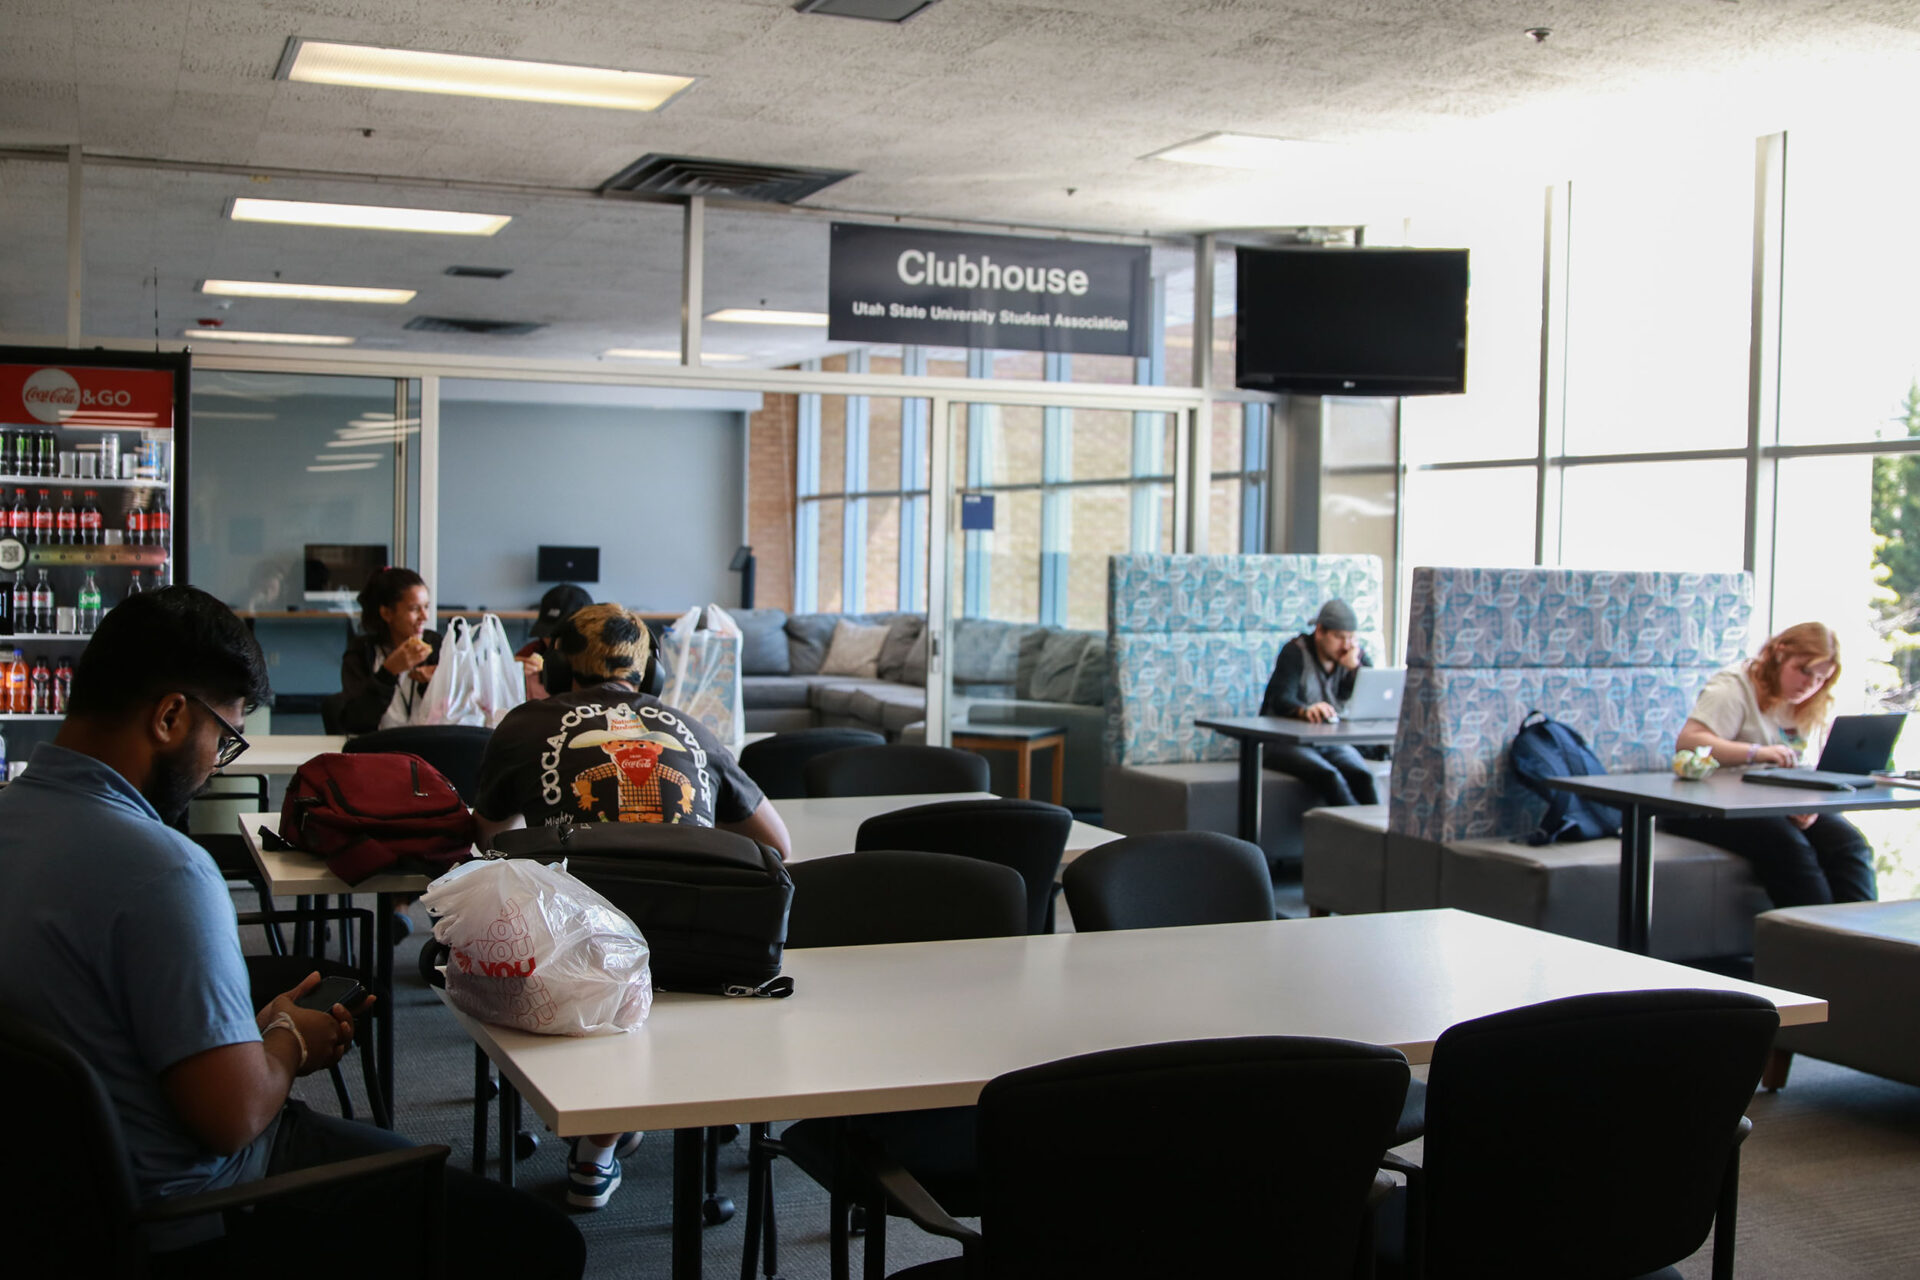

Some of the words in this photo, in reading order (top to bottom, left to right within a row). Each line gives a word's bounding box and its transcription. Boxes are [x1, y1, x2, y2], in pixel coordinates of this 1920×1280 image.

[897, 248, 1090, 296] Clubhouse
[852, 301, 885, 317] Utah
[889, 303, 927, 319] State
[930, 305, 996, 325] University
[999, 309, 1051, 327] Student
[1054, 313, 1129, 331] Association
[541, 702, 635, 806] COCA-COLA
[640, 705, 712, 813] COWBOY
[544, 810, 575, 828] Mighty
[475, 935, 535, 962] YOU
[478, 956, 537, 978] YOU
